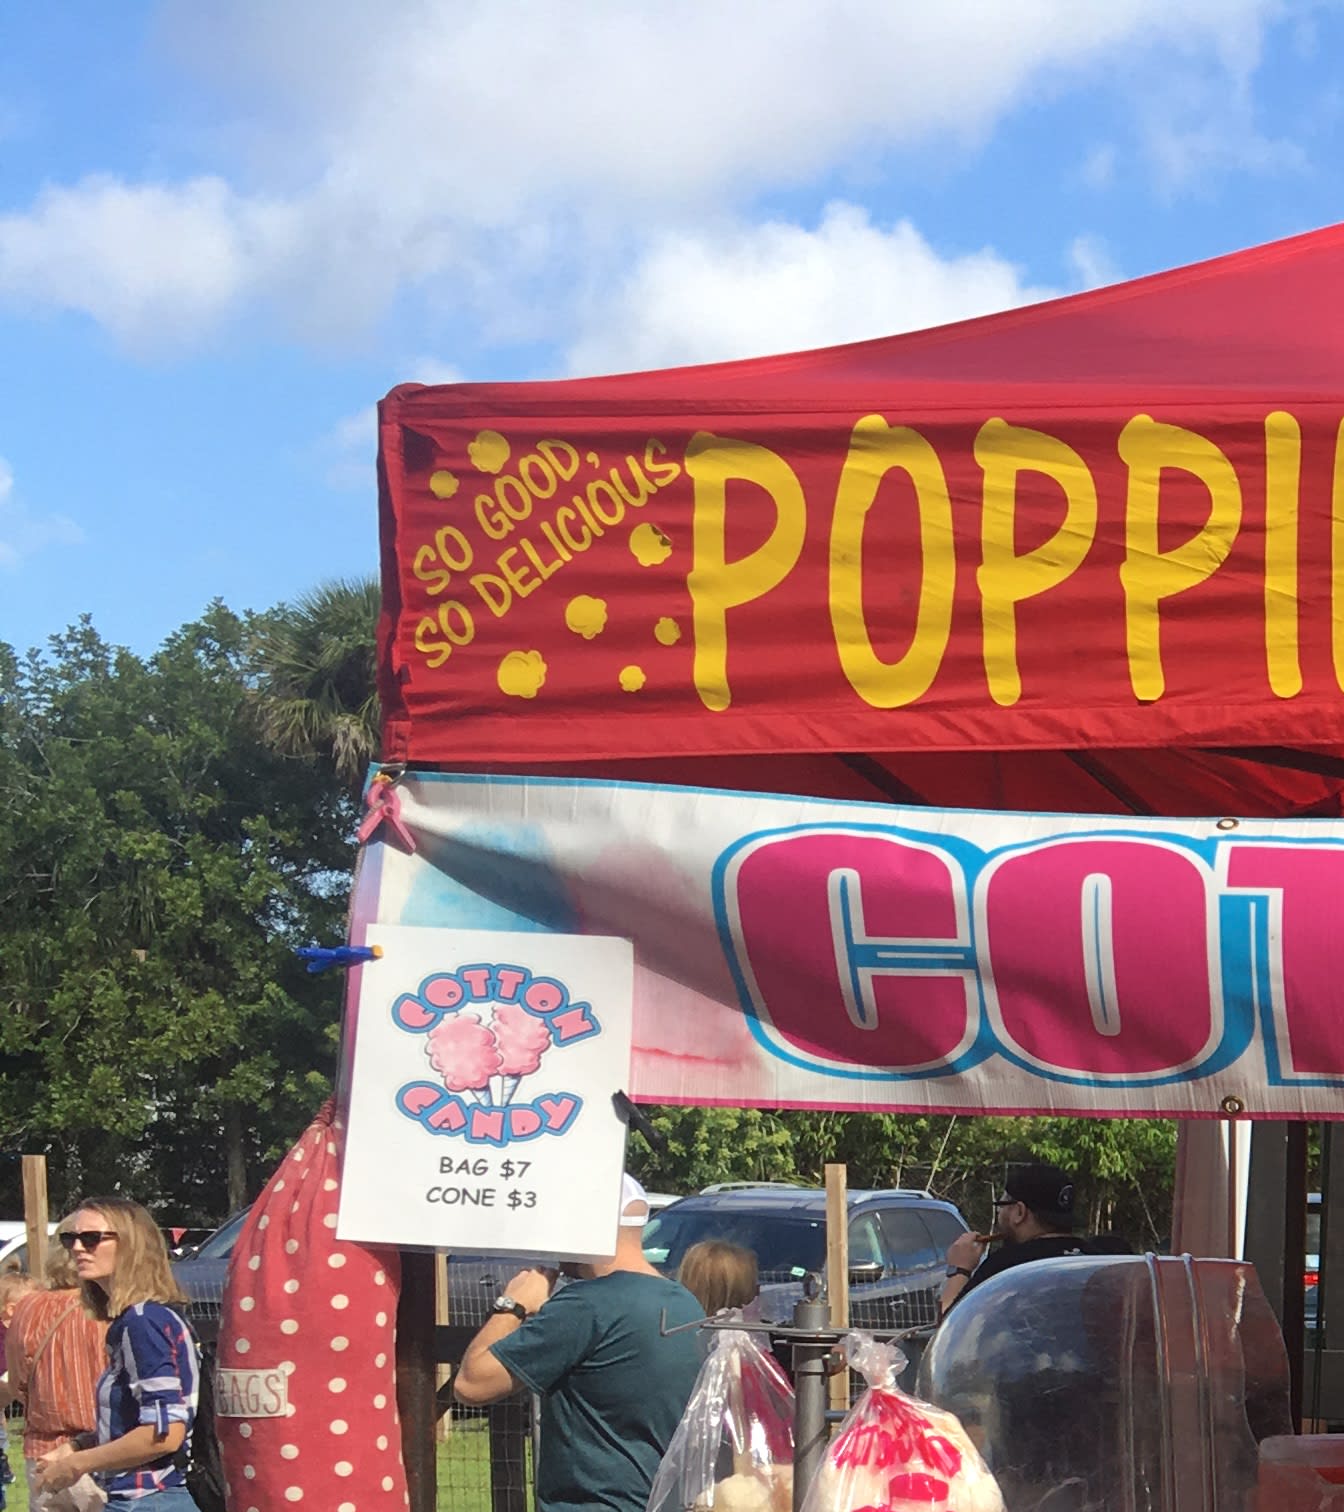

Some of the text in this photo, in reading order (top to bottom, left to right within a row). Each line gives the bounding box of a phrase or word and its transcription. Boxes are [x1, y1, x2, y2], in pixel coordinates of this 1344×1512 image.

[413, 437, 602, 595] SO GOOD,
[414, 438, 684, 670] SO DELICIOUS
[391, 962, 602, 1049] COTTON
[394, 1079, 584, 1148] CANDY
[426, 1187, 538, 1211] CONE $3
[439, 1156, 532, 1181] BAG $7
